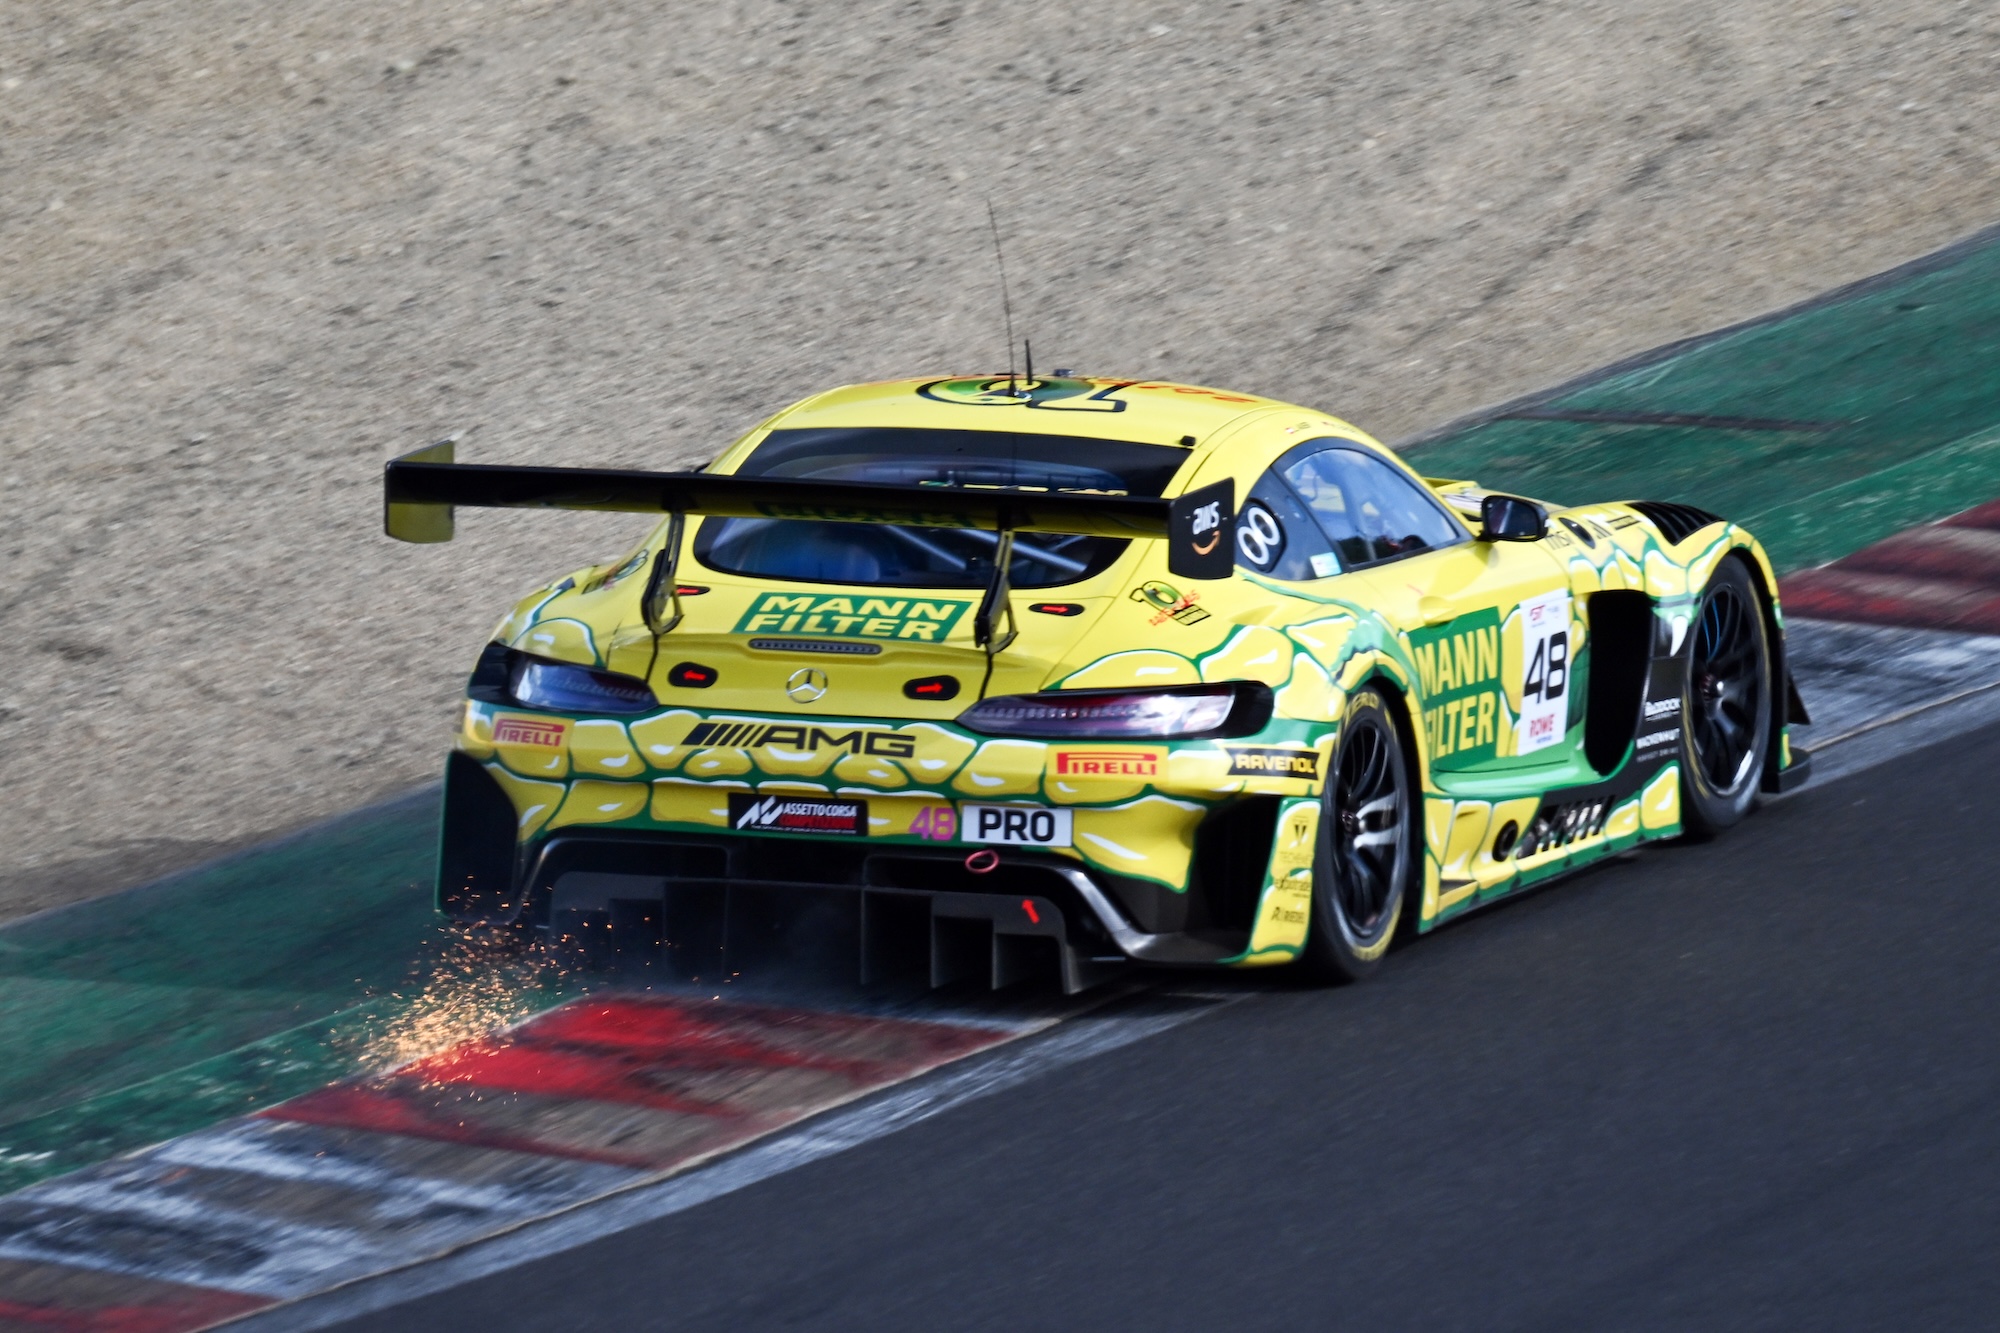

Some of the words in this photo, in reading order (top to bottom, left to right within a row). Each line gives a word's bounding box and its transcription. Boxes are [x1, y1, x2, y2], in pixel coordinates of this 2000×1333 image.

[1192, 500, 1220, 535] aws
[758, 595, 958, 621] MANN
[743, 613, 941, 640] FILTER
[1414, 625, 1498, 700] MANN
[1523, 630, 1568, 704] 48
[492, 719, 566, 747] PIRELLI
[751, 724, 917, 759] AMG
[1056, 752, 1158, 776] PIRELLI
[1234, 753, 1316, 774] RAVENOL
[782, 802, 825, 816] ASSETTO
[825, 804, 857, 817] CORSA
[908, 806, 957, 841] 48
[978, 807, 1056, 842] PRO
